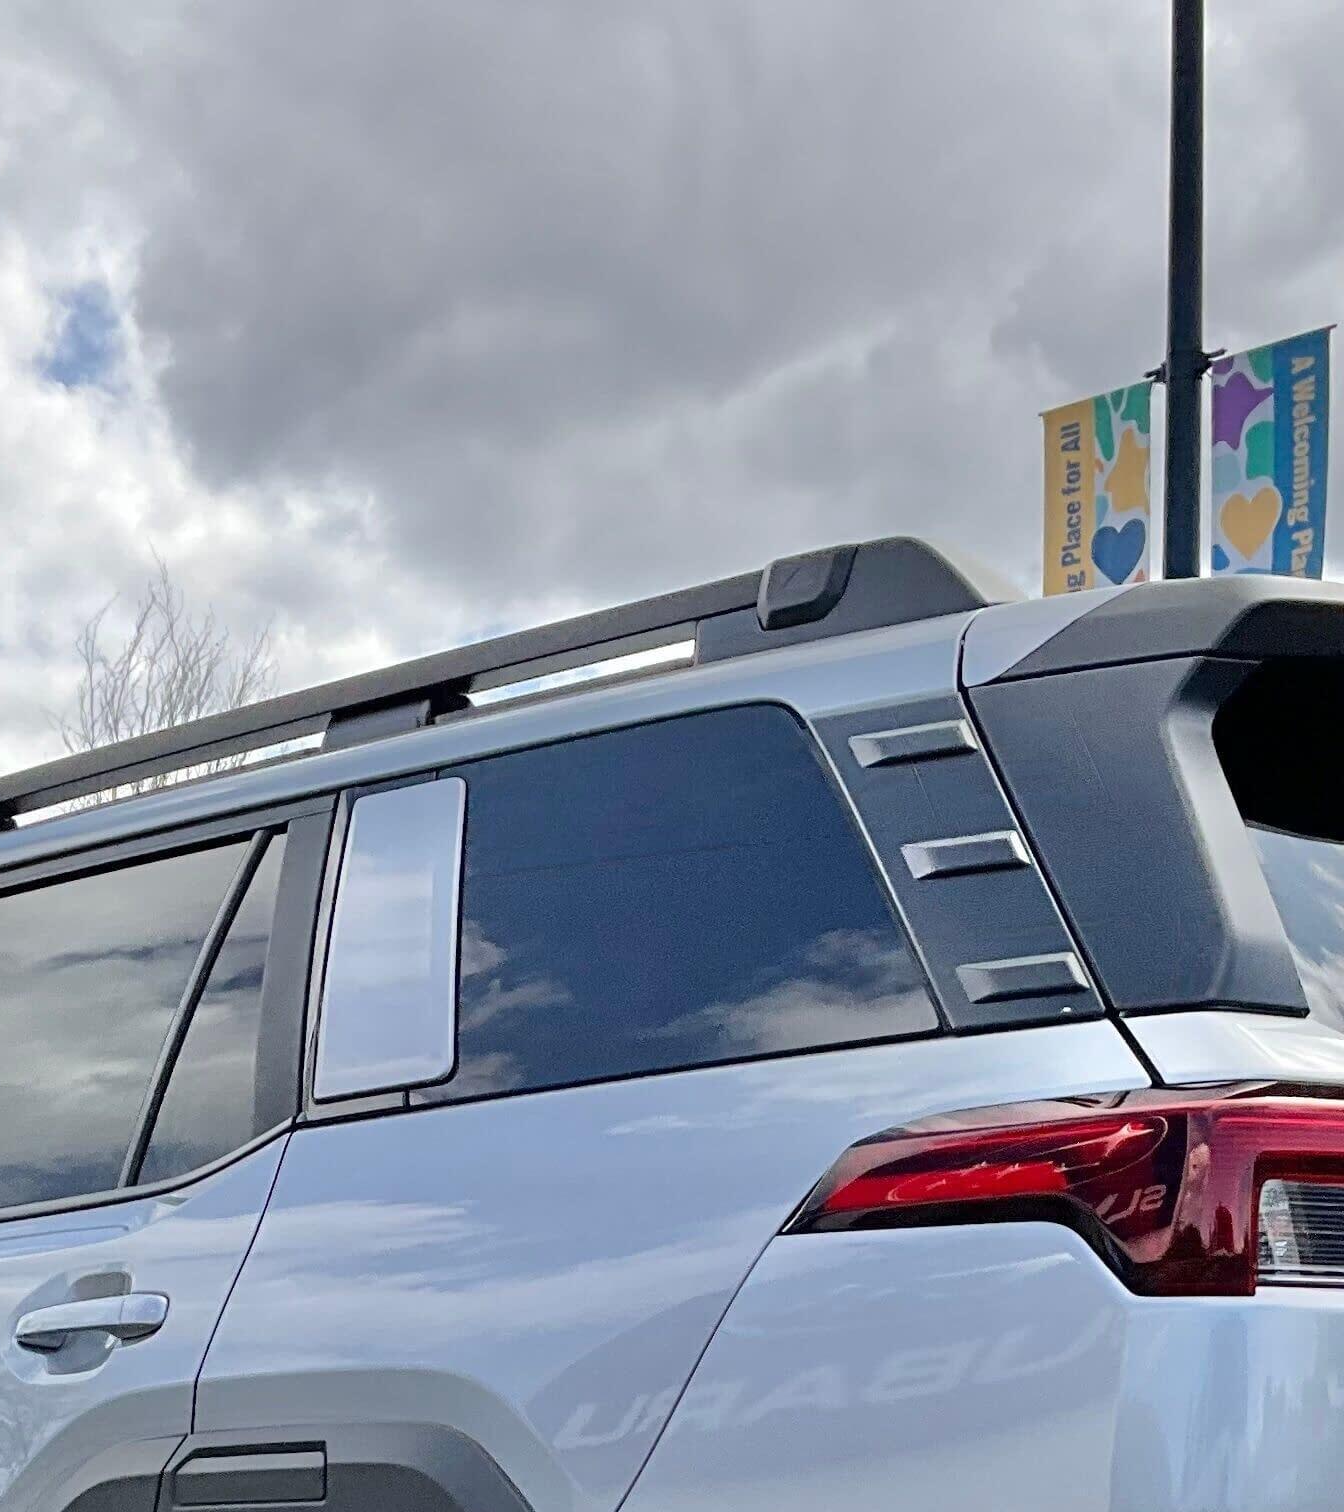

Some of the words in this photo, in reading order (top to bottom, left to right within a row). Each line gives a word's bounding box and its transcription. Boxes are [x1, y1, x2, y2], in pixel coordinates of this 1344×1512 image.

[1291, 356, 1316, 374] A
[1060, 421, 1081, 453] All
[1287, 375, 1316, 527] Welcoming
[1061, 460, 1082, 496] for
[1061, 500, 1082, 567] Place
